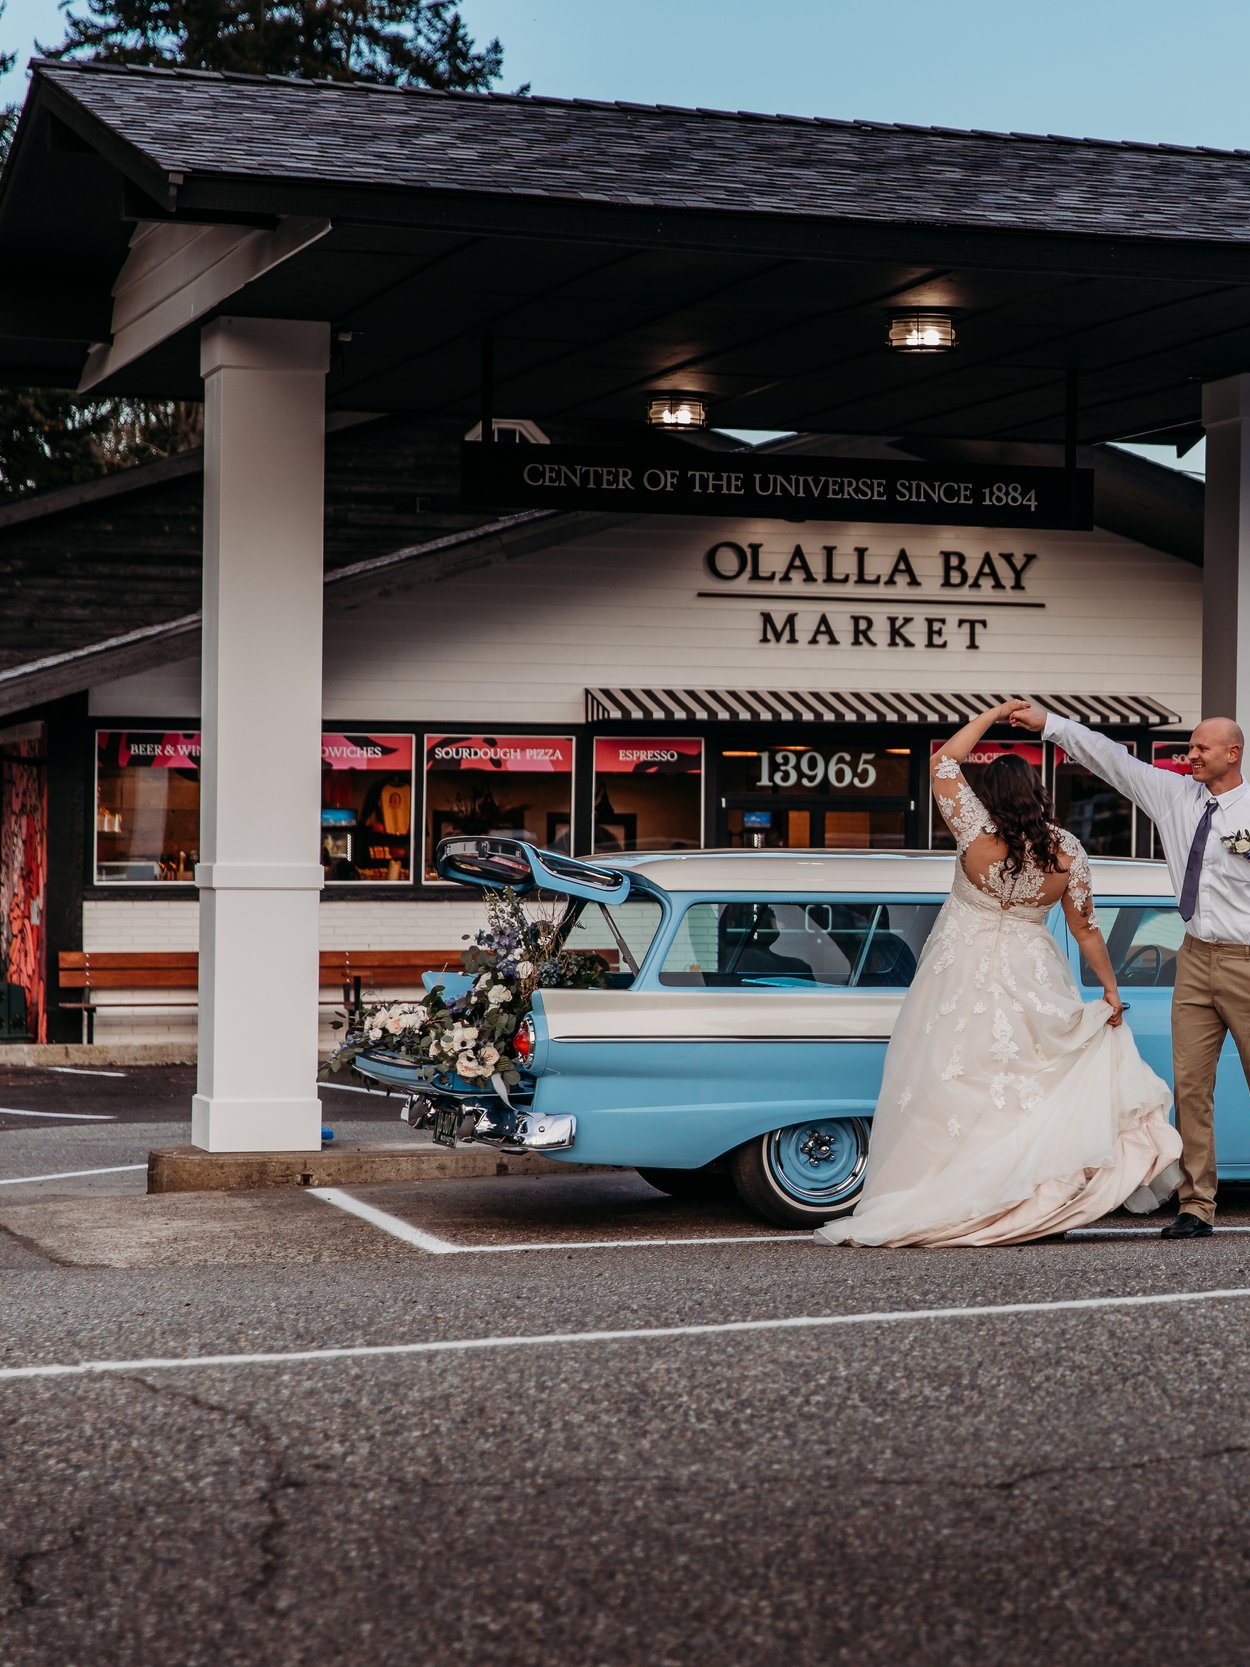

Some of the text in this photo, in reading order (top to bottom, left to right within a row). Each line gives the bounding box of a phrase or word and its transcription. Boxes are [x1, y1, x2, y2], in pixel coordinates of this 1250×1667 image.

[523, 463, 1038, 511] CENTER OF THE UNIVERSE SINCE 1884
[707, 540, 1038, 590] OLALLA BAY
[759, 611, 988, 649] MARKET
[130, 743, 201, 757] BEER & WIN
[321, 745, 382, 758] DWICHES
[434, 747, 563, 760] SOURDOUGH PIZZA
[618, 749, 678, 761] ESPRESSO
[755, 751, 877, 788] 13965
